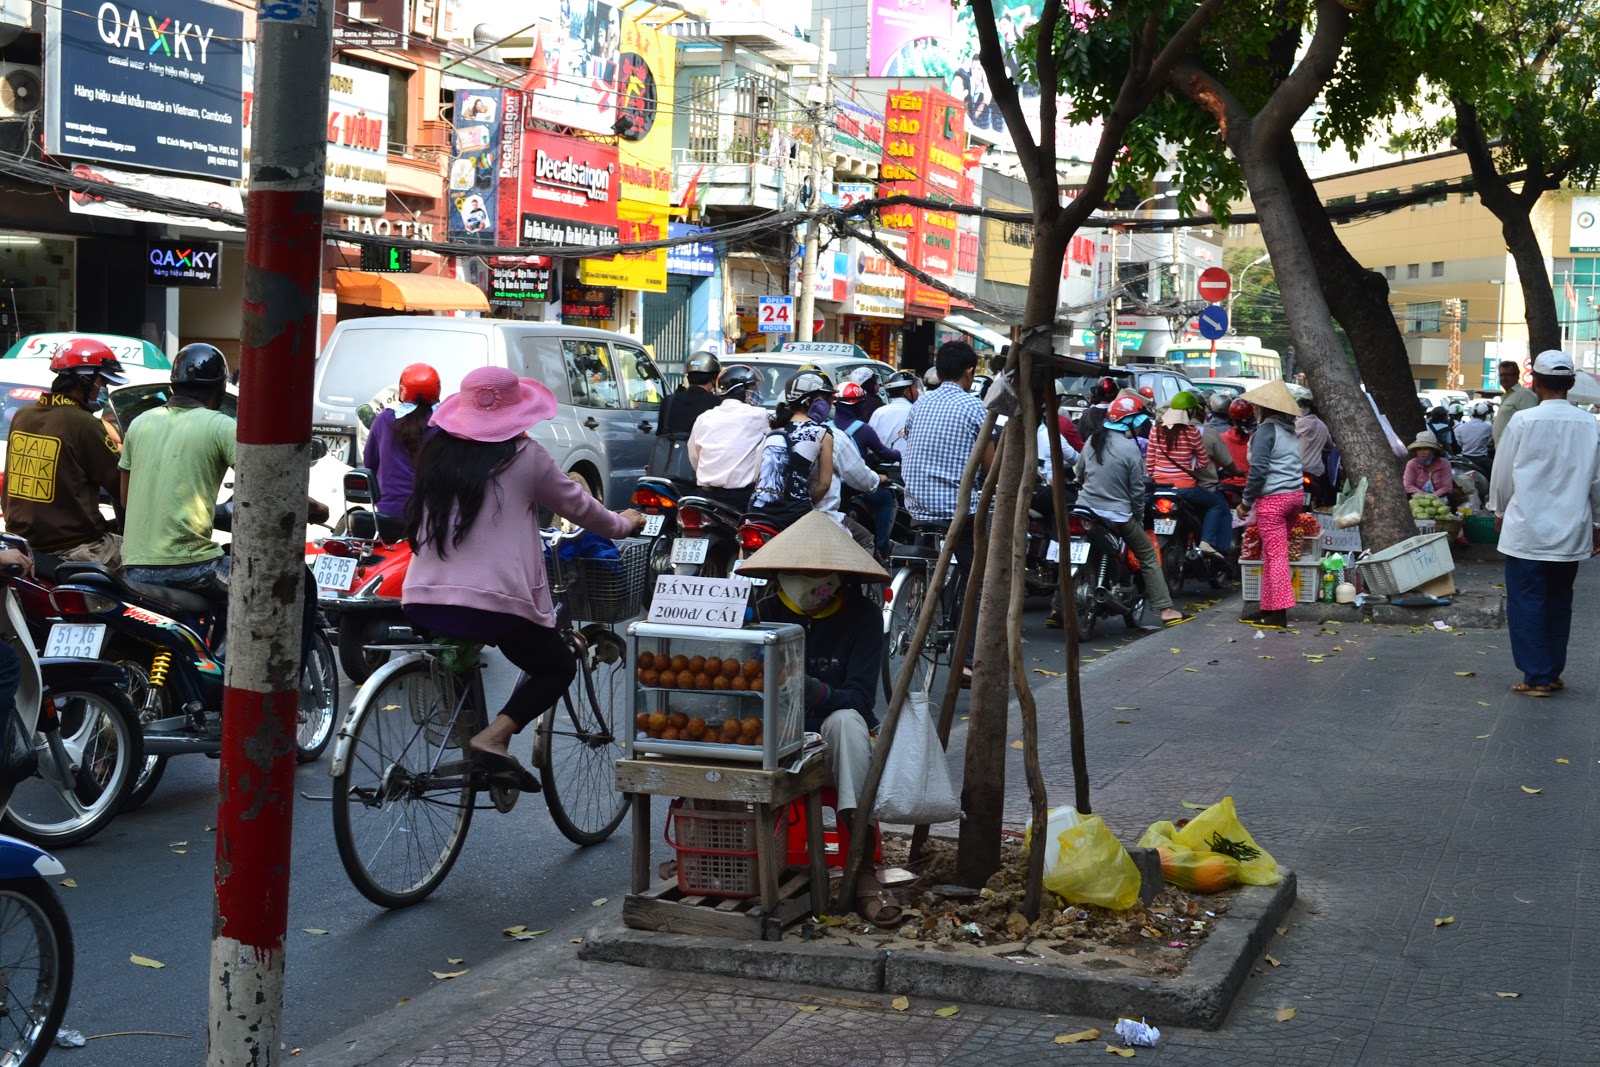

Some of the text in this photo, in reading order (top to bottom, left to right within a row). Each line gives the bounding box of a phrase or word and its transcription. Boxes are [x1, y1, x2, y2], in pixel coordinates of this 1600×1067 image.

[97, 2, 214, 64] QAXKY
[74, 84, 94, 101] Hàng
[95, 87, 111, 103] hiệu
[146, 98, 164, 112] made
[165, 102, 172, 113] in
[173, 103, 200, 119] Vietnam,
[201, 109, 232, 124] Cambodia
[888, 115, 919, 134] SÀO
[500, 95, 514, 178] Decalsaigon
[888, 139, 915, 157] SÀI
[535, 149, 609, 195] Decalsaigon
[150, 249, 217, 268] QAXKY
[762, 305, 789, 322] 24
[121, 347, 141, 359] 27
[12, 437, 51, 458] CAL
[321, 557, 350, 573] 54-R5
[675, 551, 701, 562] 5898
[318, 572, 347, 588] 0802
[656, 579, 748, 600] BÁNH CAM
[655, 606, 737, 623] 2000đ/ CÁI
[56, 627, 97, 644] 51-X6
